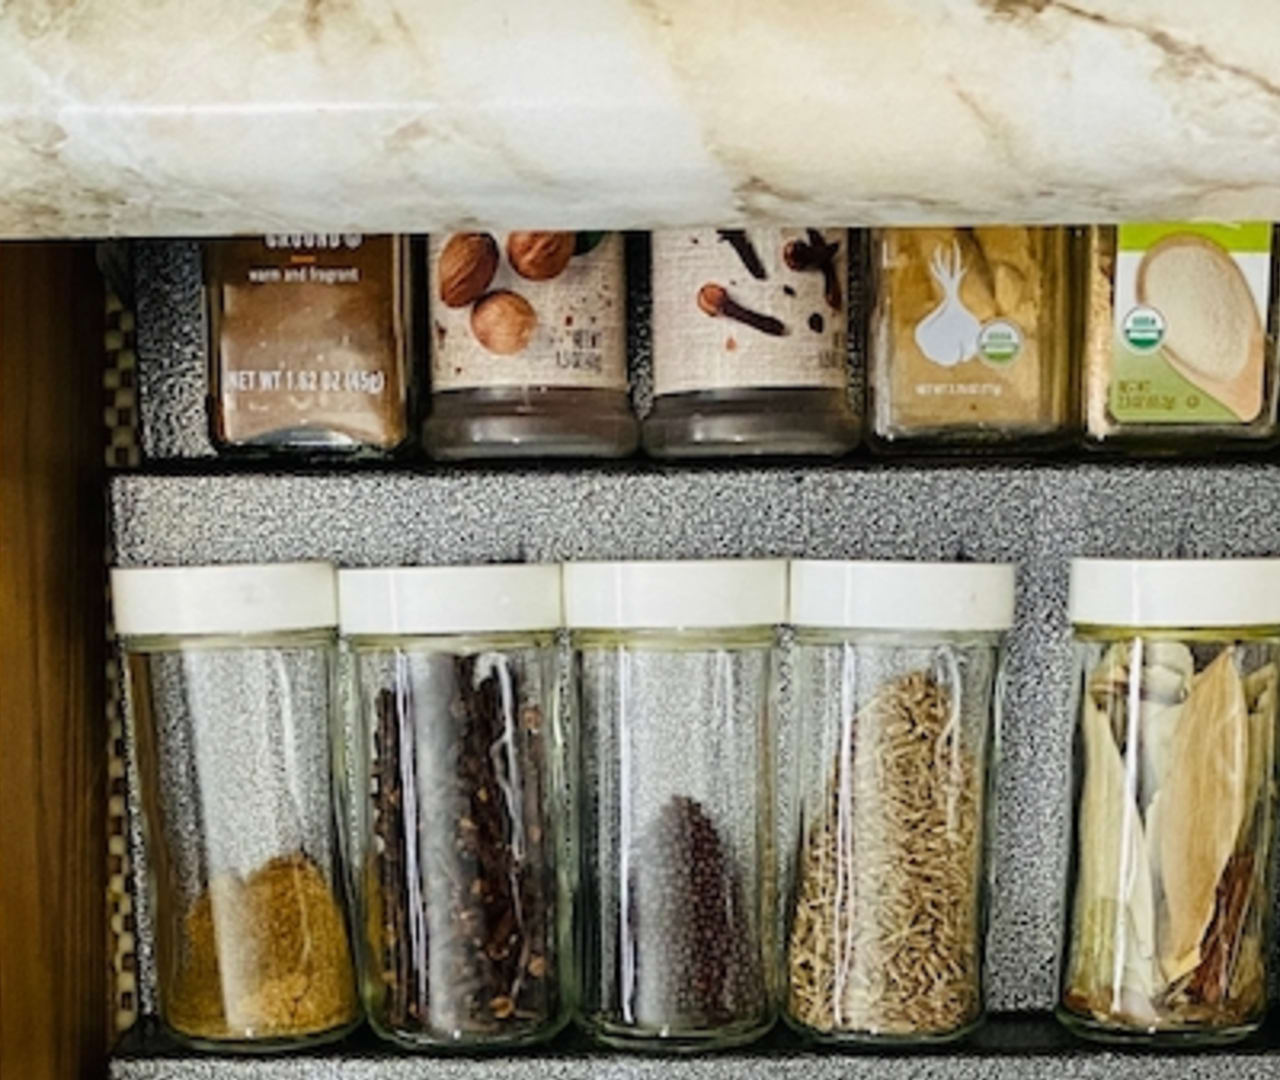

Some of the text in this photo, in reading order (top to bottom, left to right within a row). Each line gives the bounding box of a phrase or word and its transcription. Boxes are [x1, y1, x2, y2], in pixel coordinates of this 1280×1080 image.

[284, 267, 306, 282] and
[309, 267, 359, 284] fragrant
[227, 370, 254, 391] NET
[259, 370, 281, 391] WT
